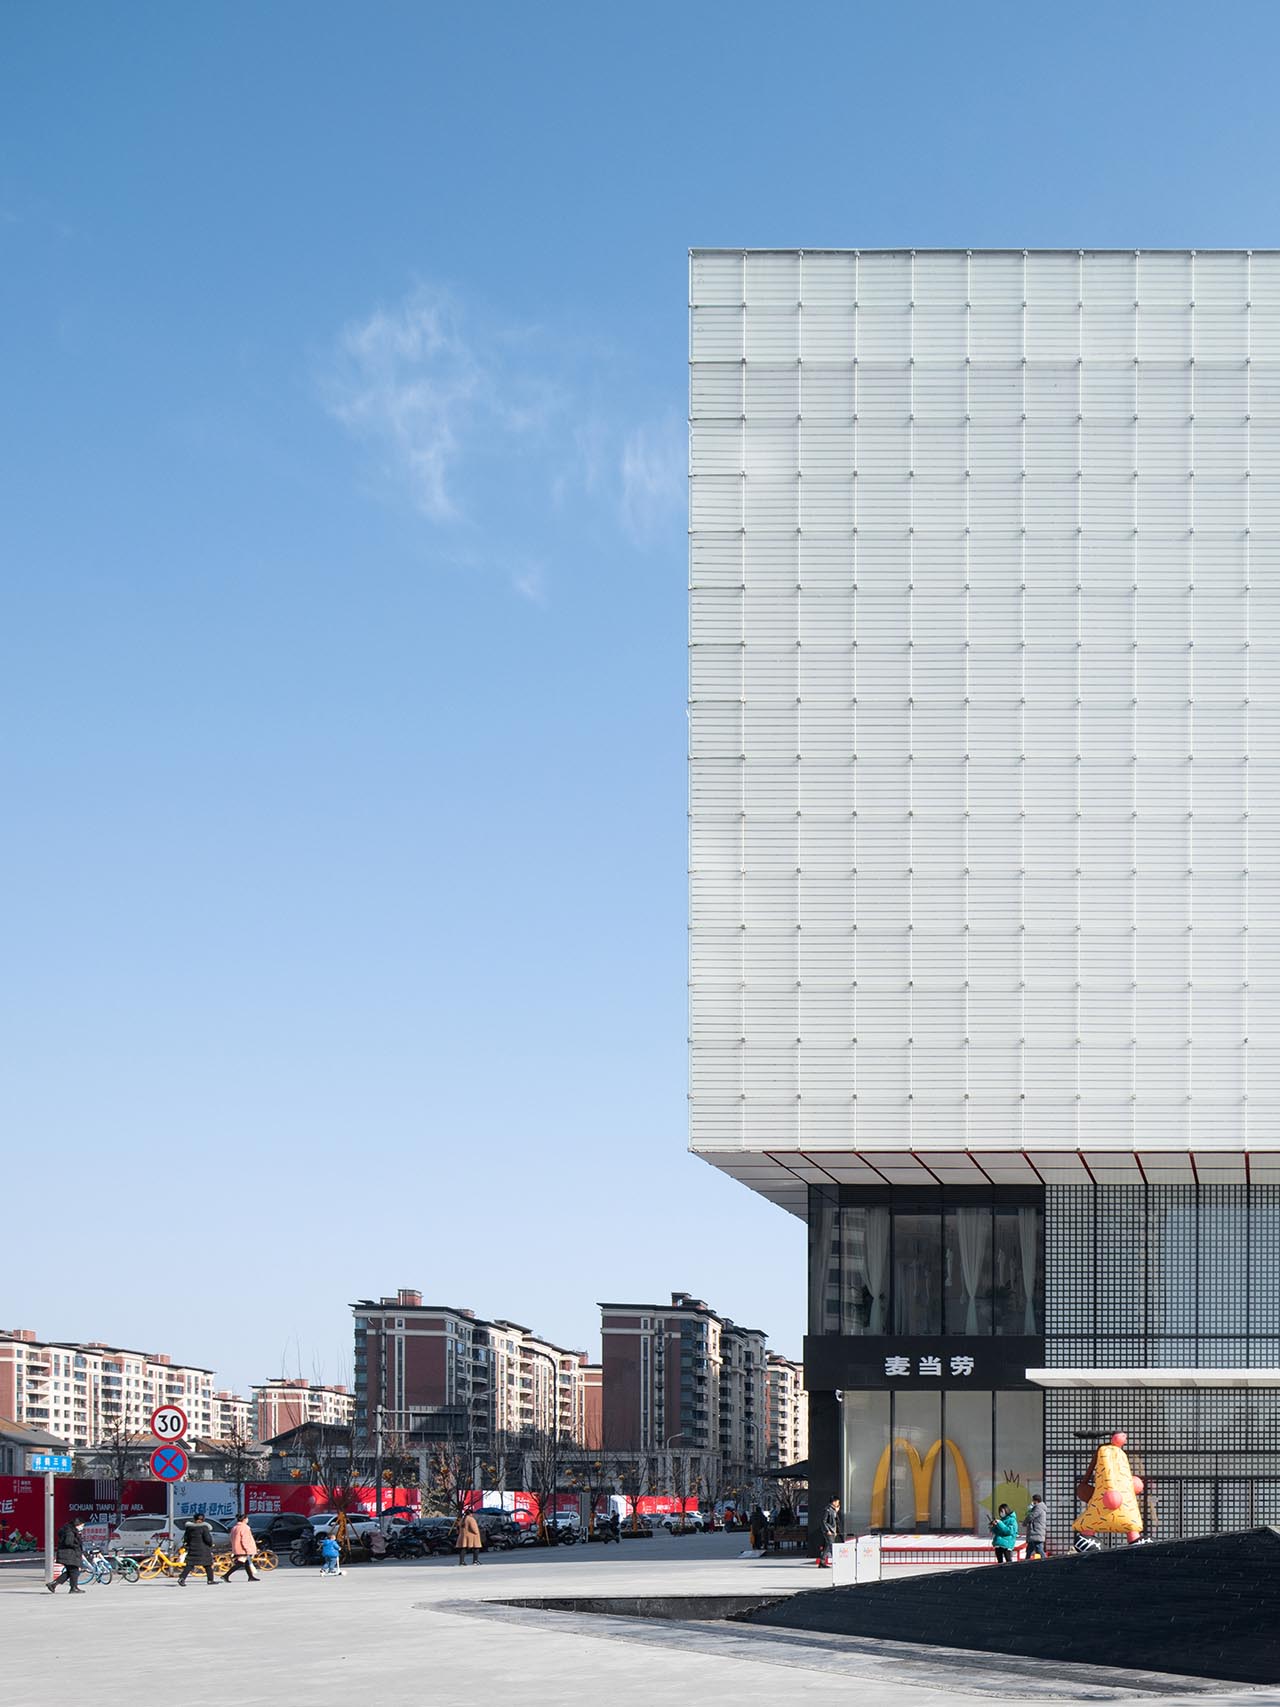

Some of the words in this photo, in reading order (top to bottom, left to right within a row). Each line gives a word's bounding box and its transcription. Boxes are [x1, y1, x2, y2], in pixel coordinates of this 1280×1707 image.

[884, 1355, 975, 1377] 麦当劳
[158, 1415, 181, 1433] 30
[68, 1503, 94, 1512] SICHUAN
[96, 1503, 115, 1511] TIANFU
[117, 1503, 129, 1511] EW
[131, 1503, 145, 1511] AREA
